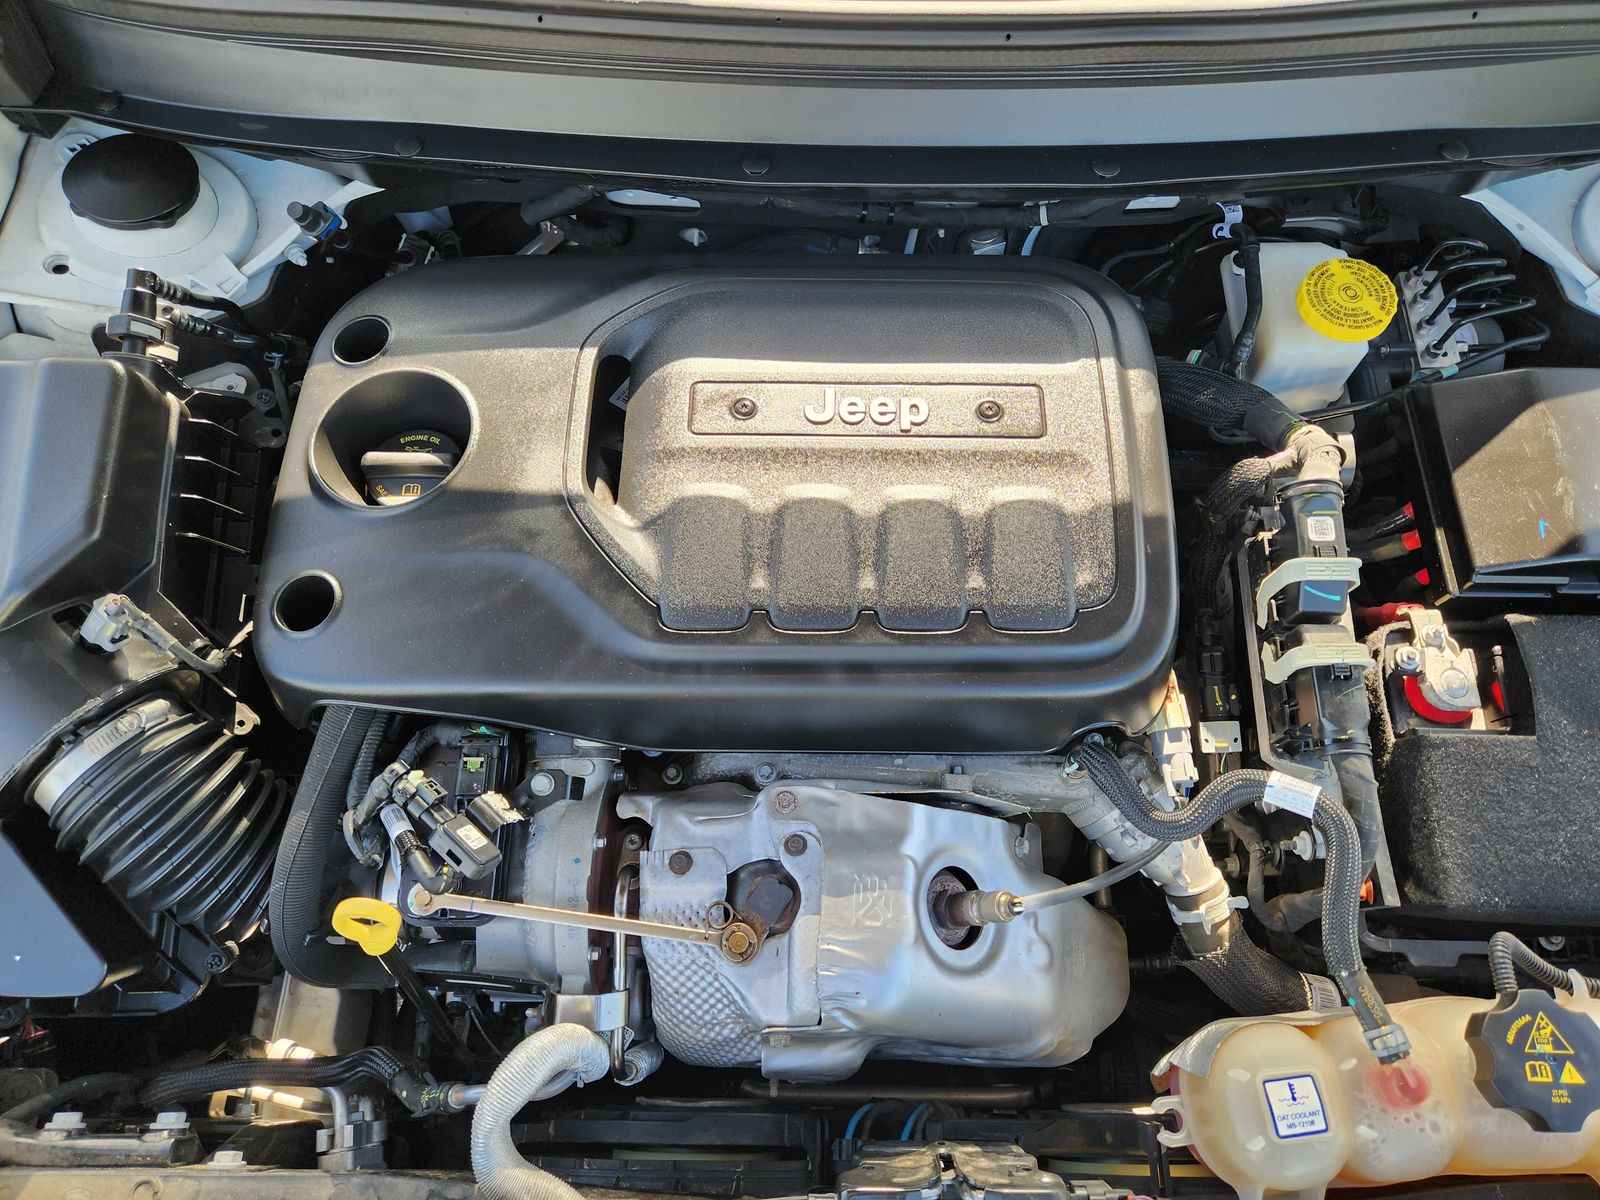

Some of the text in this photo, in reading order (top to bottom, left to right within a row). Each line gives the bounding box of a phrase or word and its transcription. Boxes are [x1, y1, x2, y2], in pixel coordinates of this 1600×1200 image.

[803, 386, 930, 433] Jeep
[399, 434, 441, 445] ENGINE OIL
[375, 484, 389, 497] SAE
[1290, 1110, 1320, 1120] COOLANT
